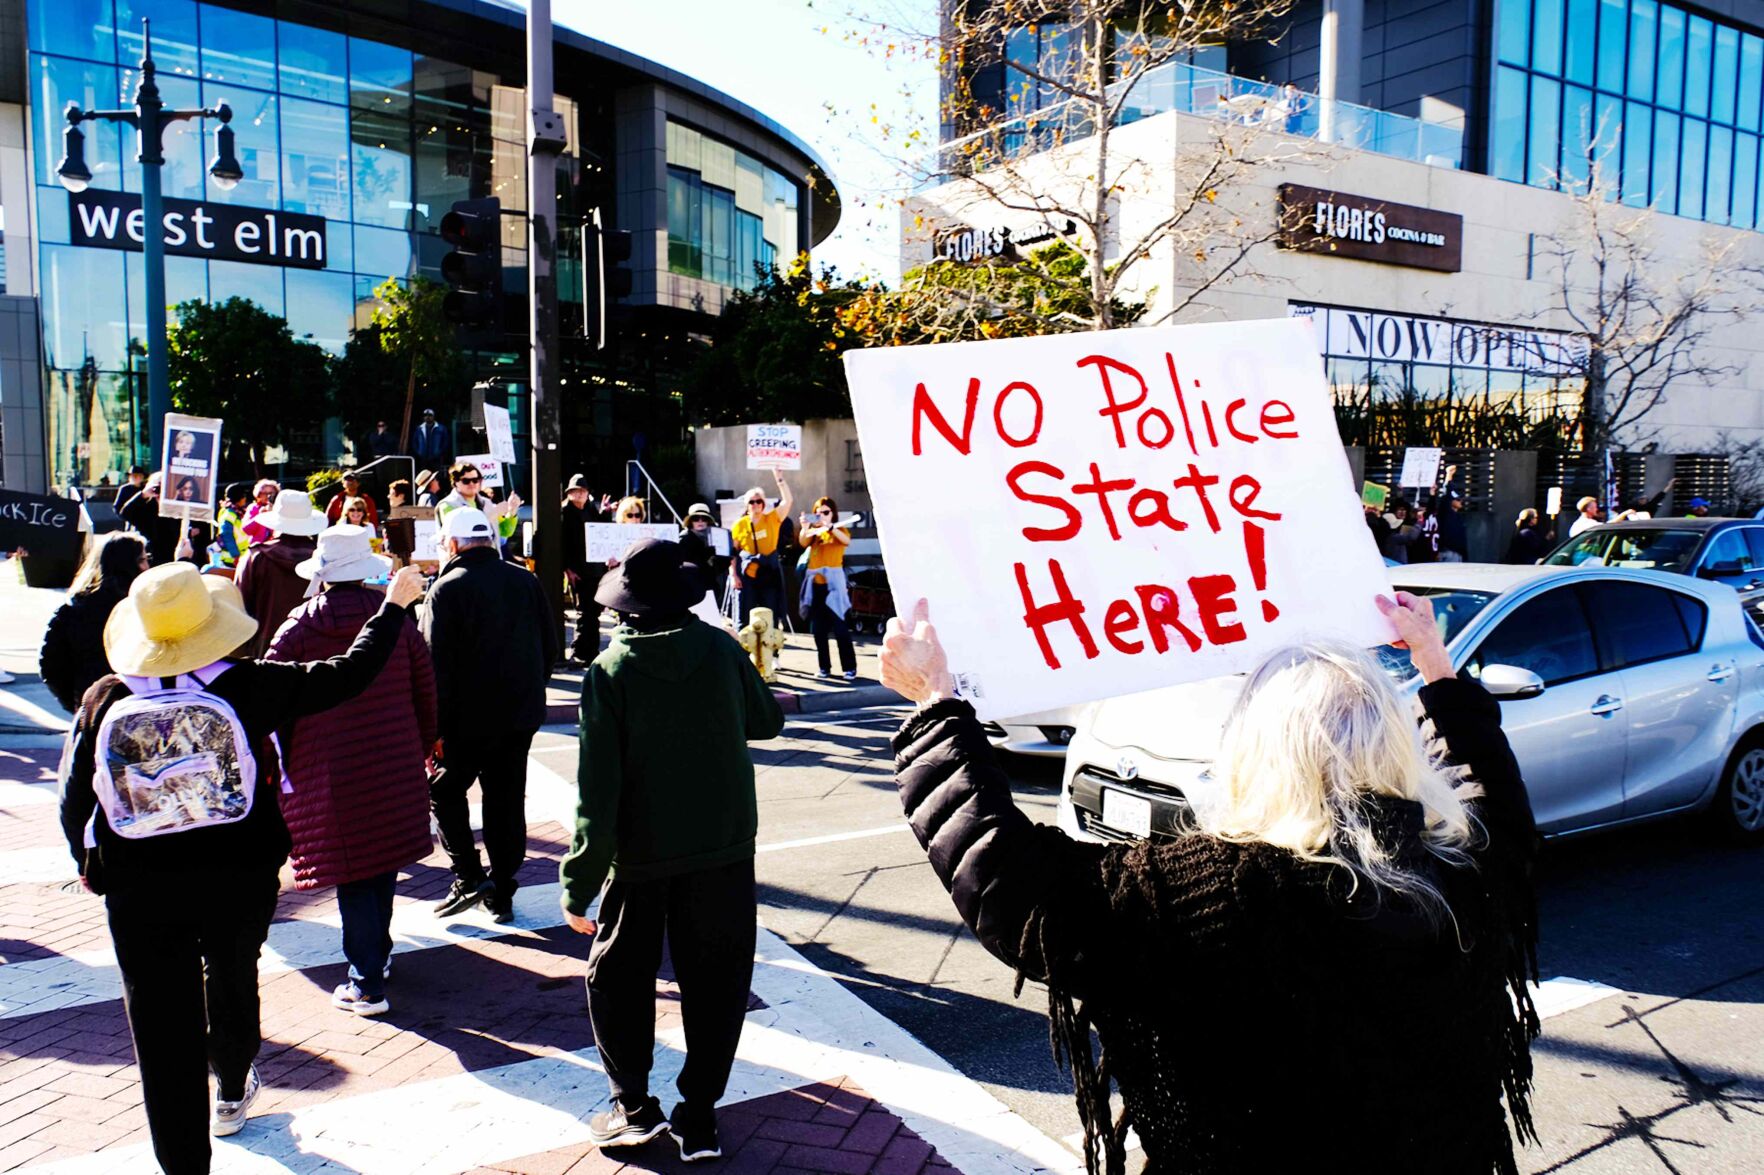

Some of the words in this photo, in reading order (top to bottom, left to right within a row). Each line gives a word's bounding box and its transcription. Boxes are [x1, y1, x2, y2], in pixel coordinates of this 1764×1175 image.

[78, 203, 214, 249] west
[234, 214, 323, 261] elm
[1315, 202, 1386, 244] FLORES
[1346, 313, 1440, 361] NOW
[1456, 326, 1550, 368] OPEN
[757, 426, 789, 437] STOP
[912, 377, 1043, 456] NO
[1076, 352, 1298, 455] Police
[749, 438, 797, 451] CREEPING
[1006, 460, 1282, 541] State
